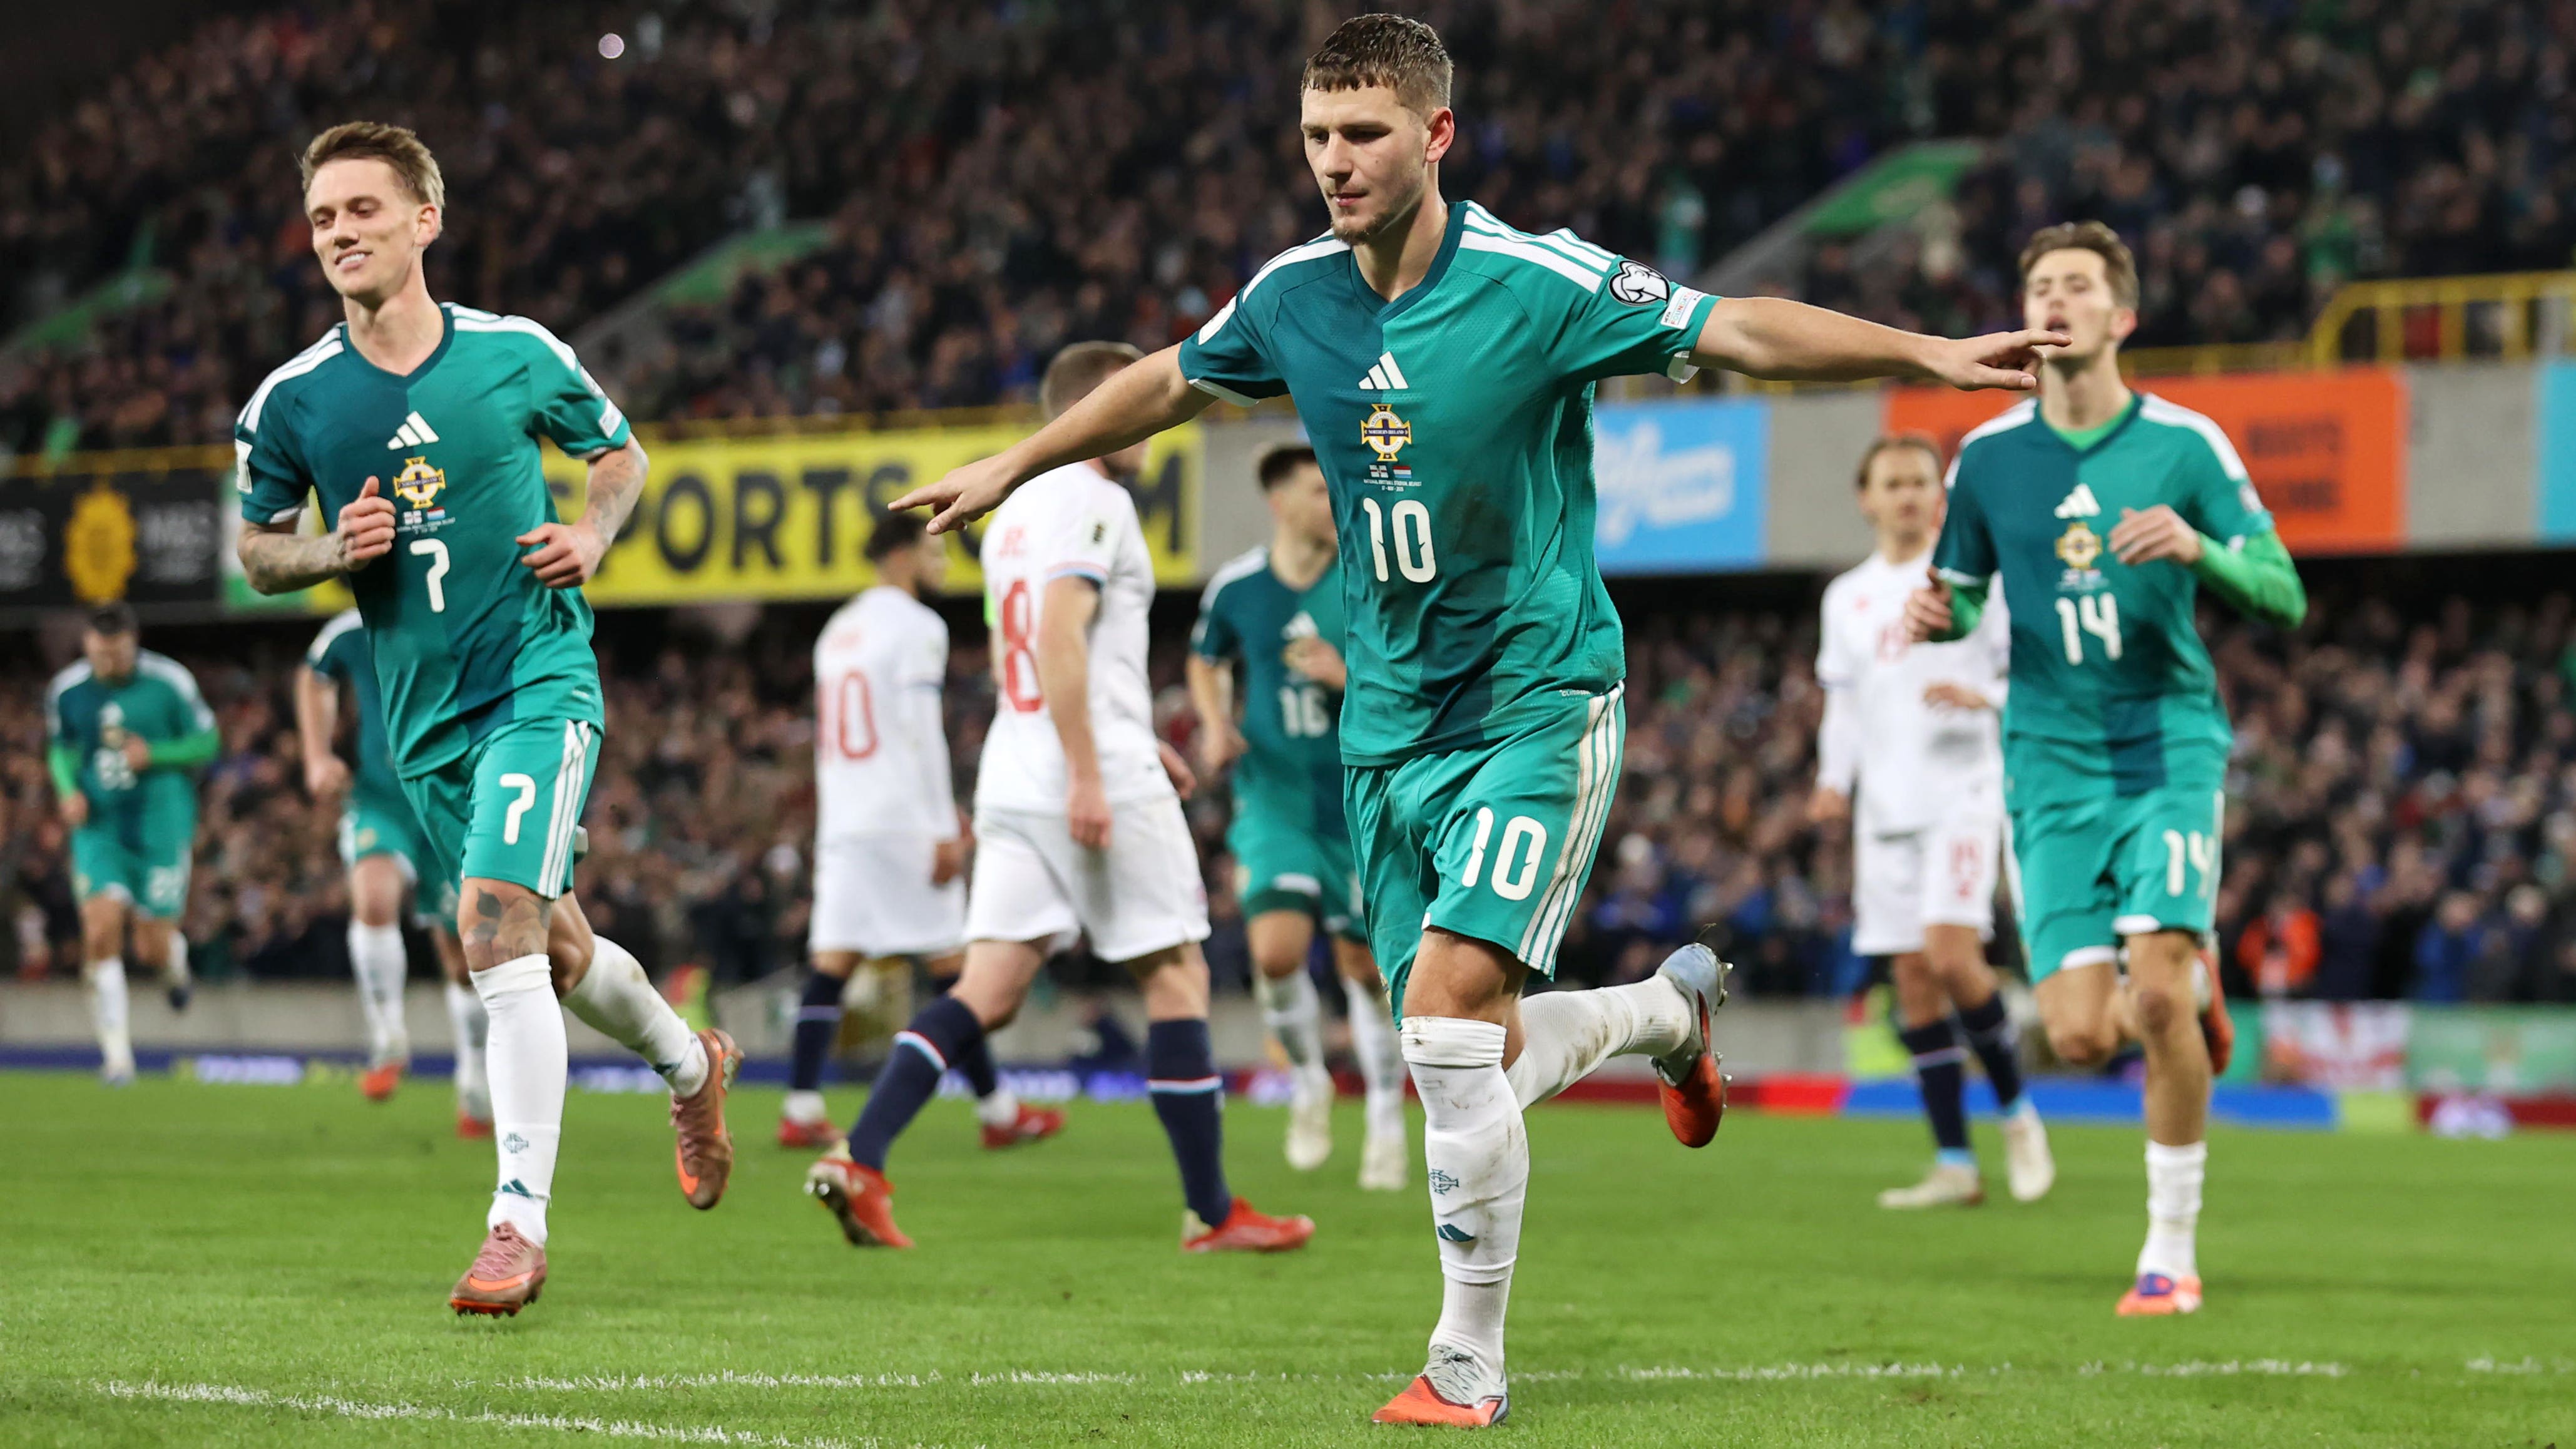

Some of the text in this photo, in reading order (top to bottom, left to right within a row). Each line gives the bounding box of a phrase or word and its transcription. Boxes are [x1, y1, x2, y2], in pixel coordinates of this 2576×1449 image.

[410, 538, 451, 613] 7
[1363, 498, 1436, 583] 10
[2055, 592, 2124, 665] 14
[1279, 686, 1331, 738] 16
[499, 773, 536, 845] 7
[1461, 807, 1548, 901] 10
[2163, 829, 2217, 898] 14
